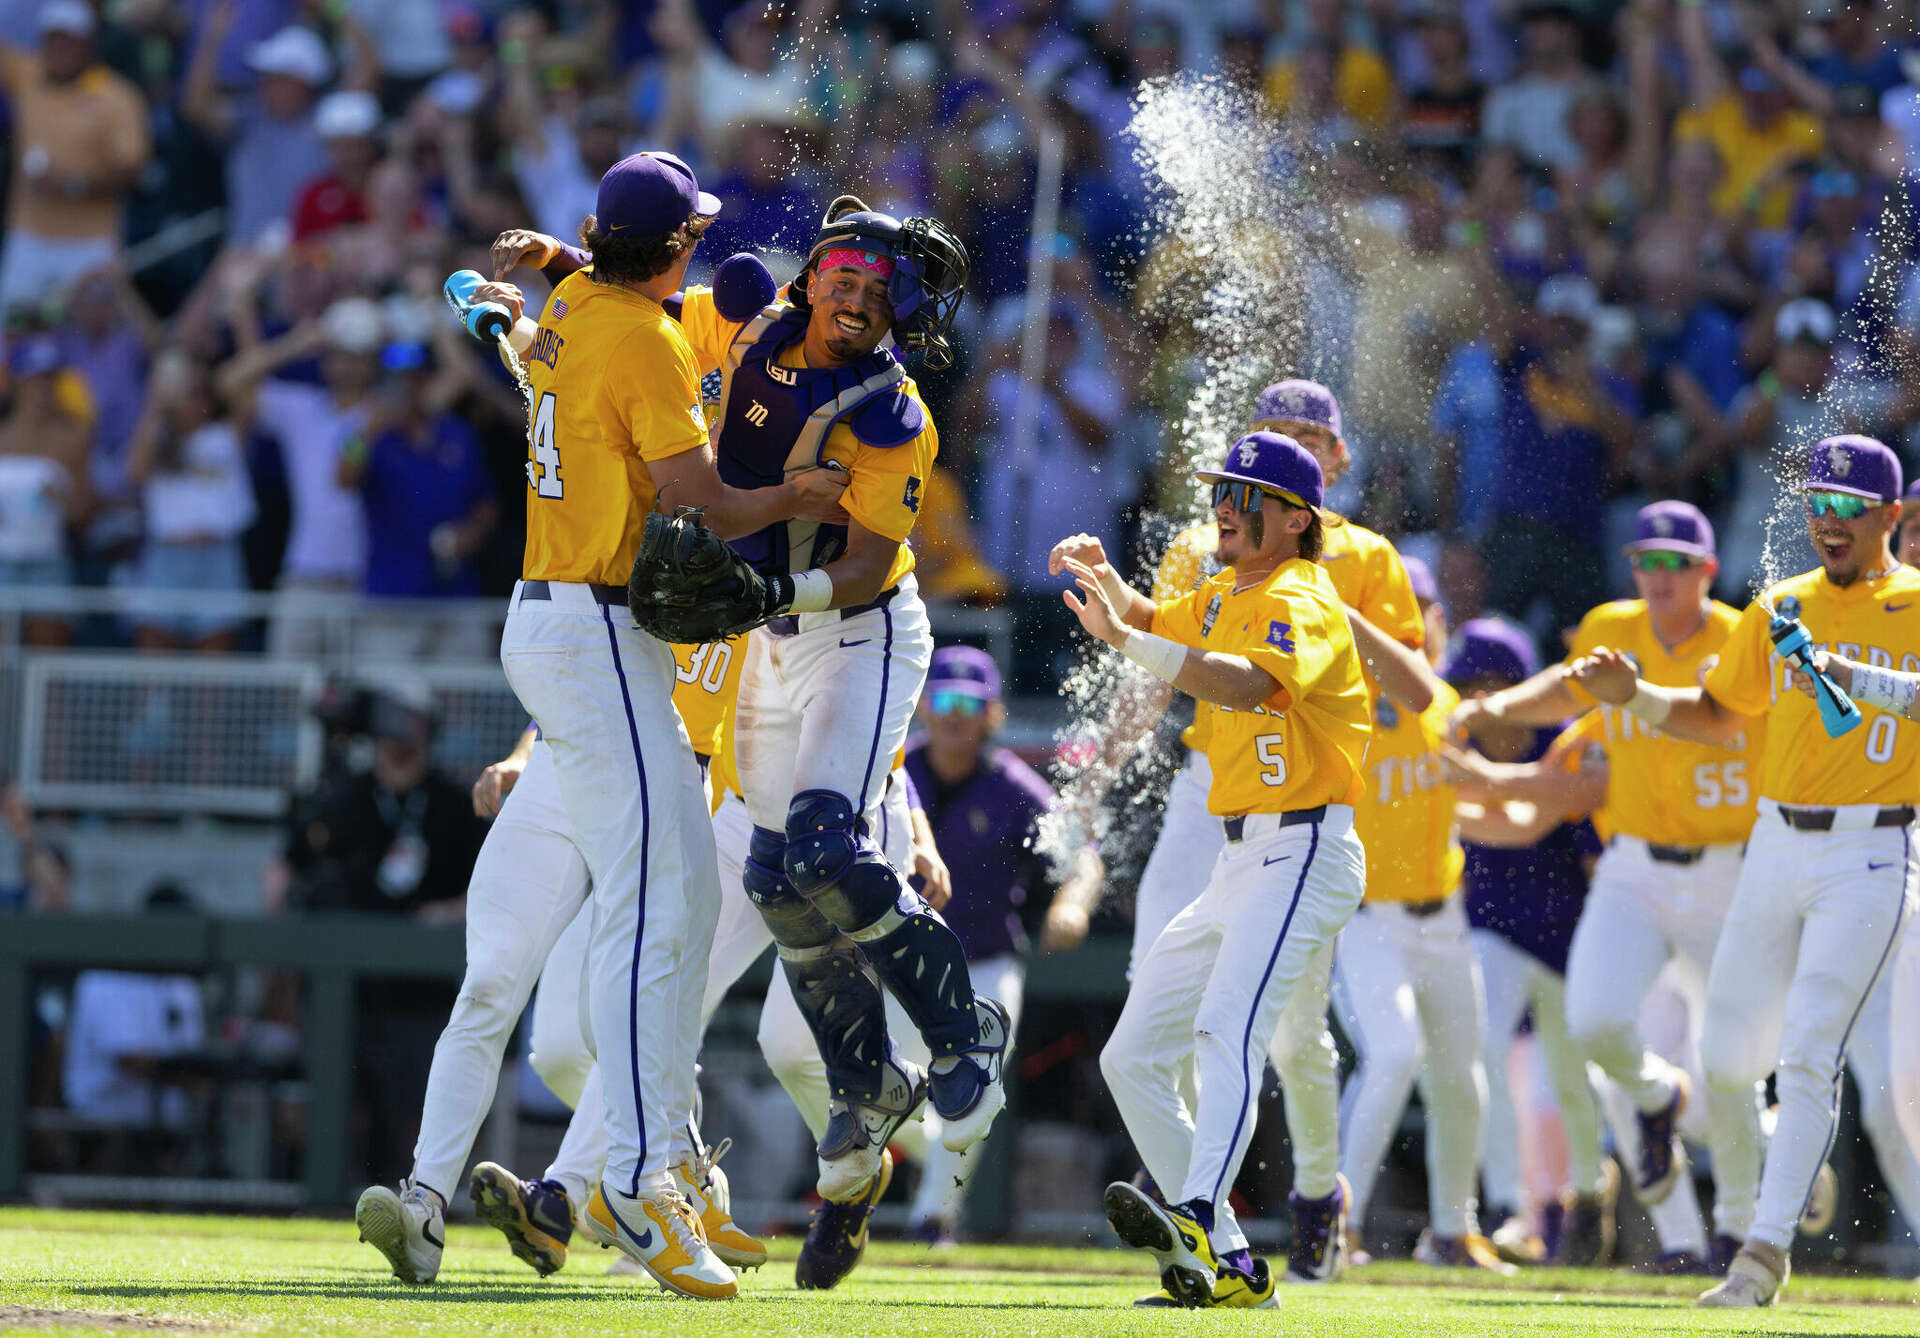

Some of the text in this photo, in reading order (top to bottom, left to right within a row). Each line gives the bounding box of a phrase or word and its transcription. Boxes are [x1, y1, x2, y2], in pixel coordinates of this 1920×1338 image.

[766, 357, 798, 387] LSU
[527, 384, 564, 500] 4
[676, 641, 733, 695] 30
[1255, 732, 1287, 787] 5
[1865, 713, 1898, 764] 0
[1694, 760, 1750, 810] 55
